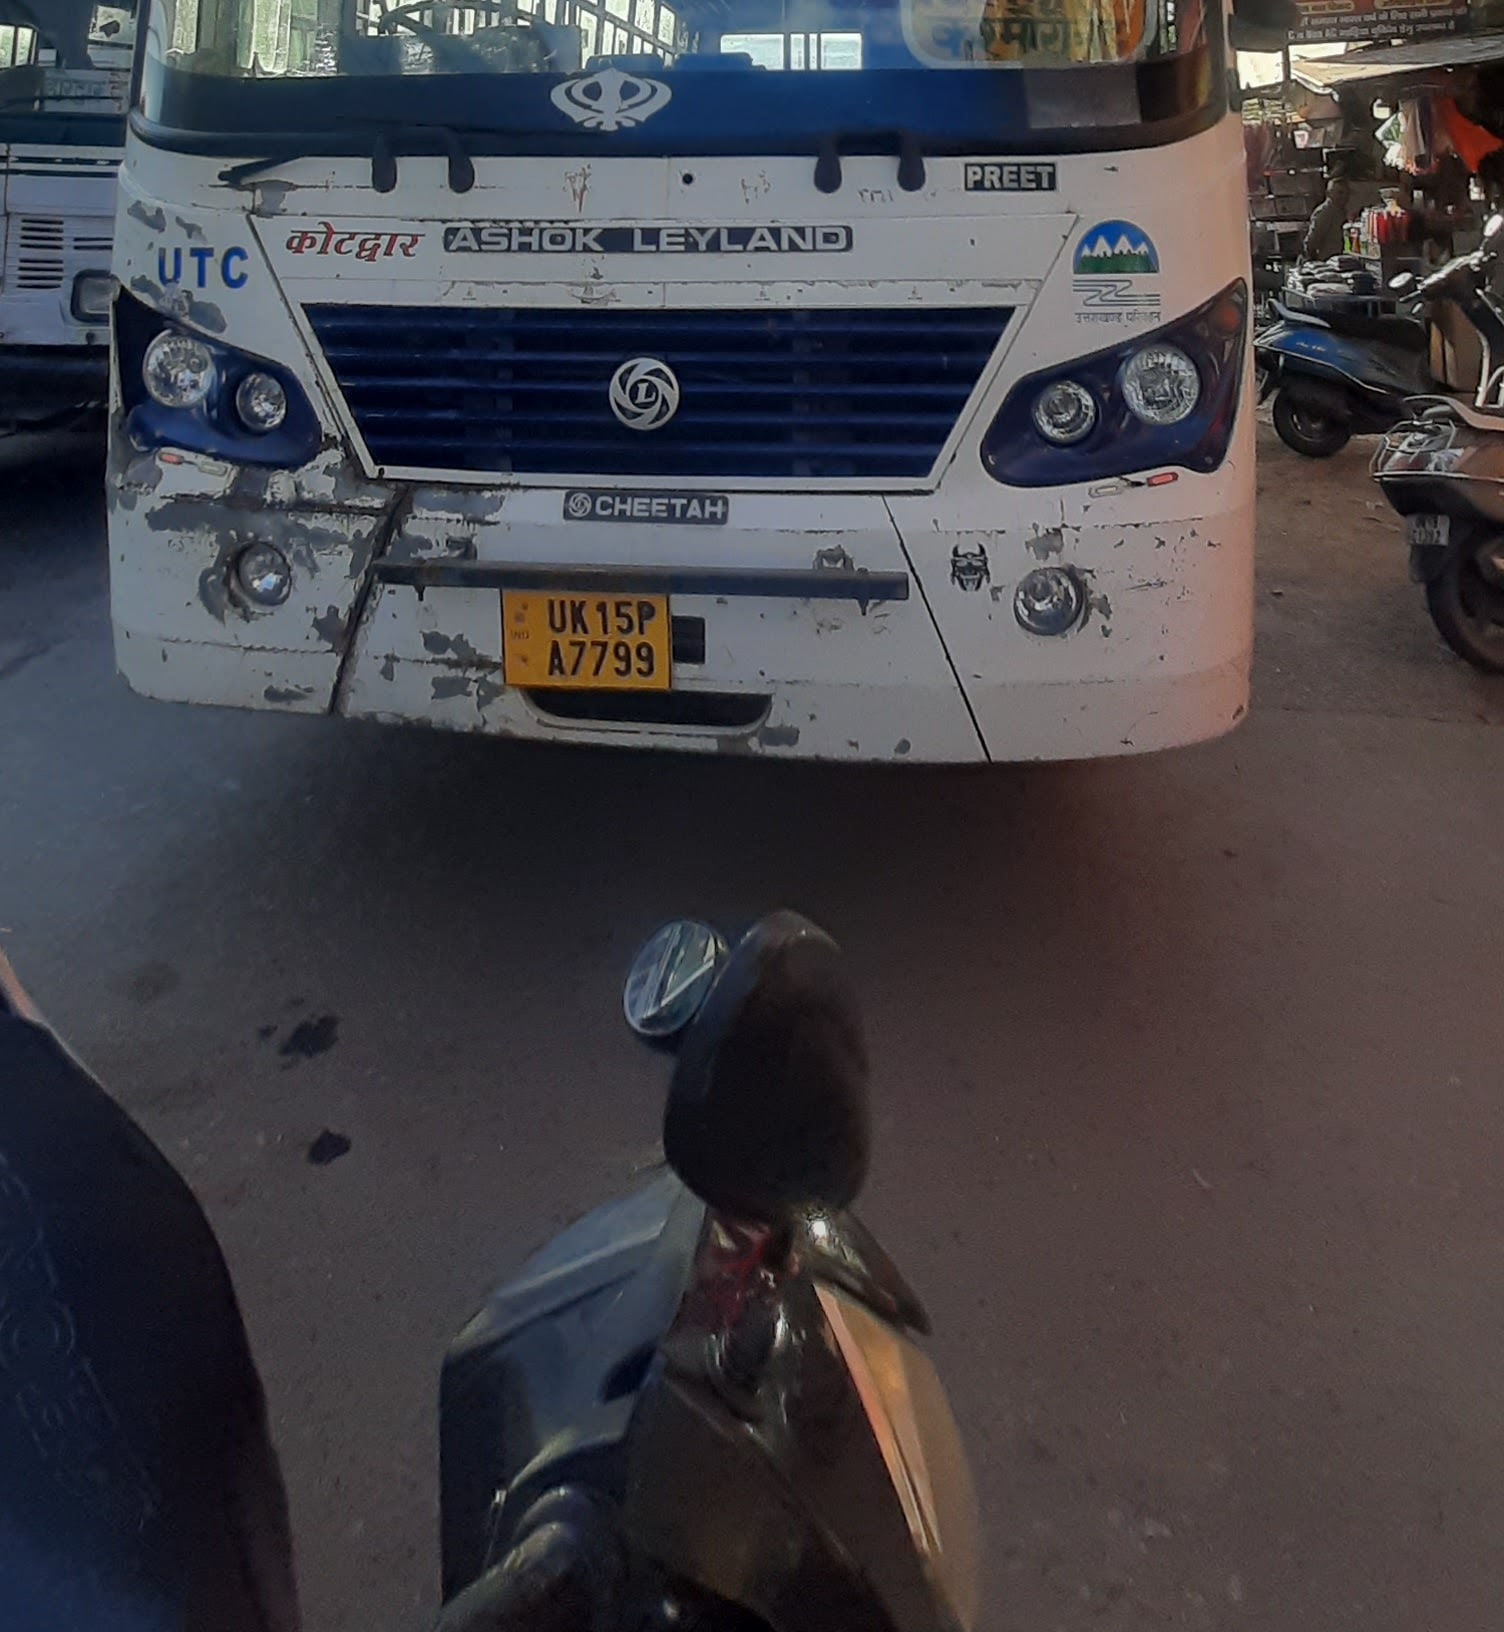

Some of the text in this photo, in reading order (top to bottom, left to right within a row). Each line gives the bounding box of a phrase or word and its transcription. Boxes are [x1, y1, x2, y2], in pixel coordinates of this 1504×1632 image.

[966, 164, 1054, 190] PREET
[285, 222, 425, 262] कोटद्वार
[448, 226, 849, 252] ASHOK LEYLAND
[157, 247, 248, 288] UTC
[595, 496, 726, 520] CHEETAH
[548, 640, 655, 678] A7799
